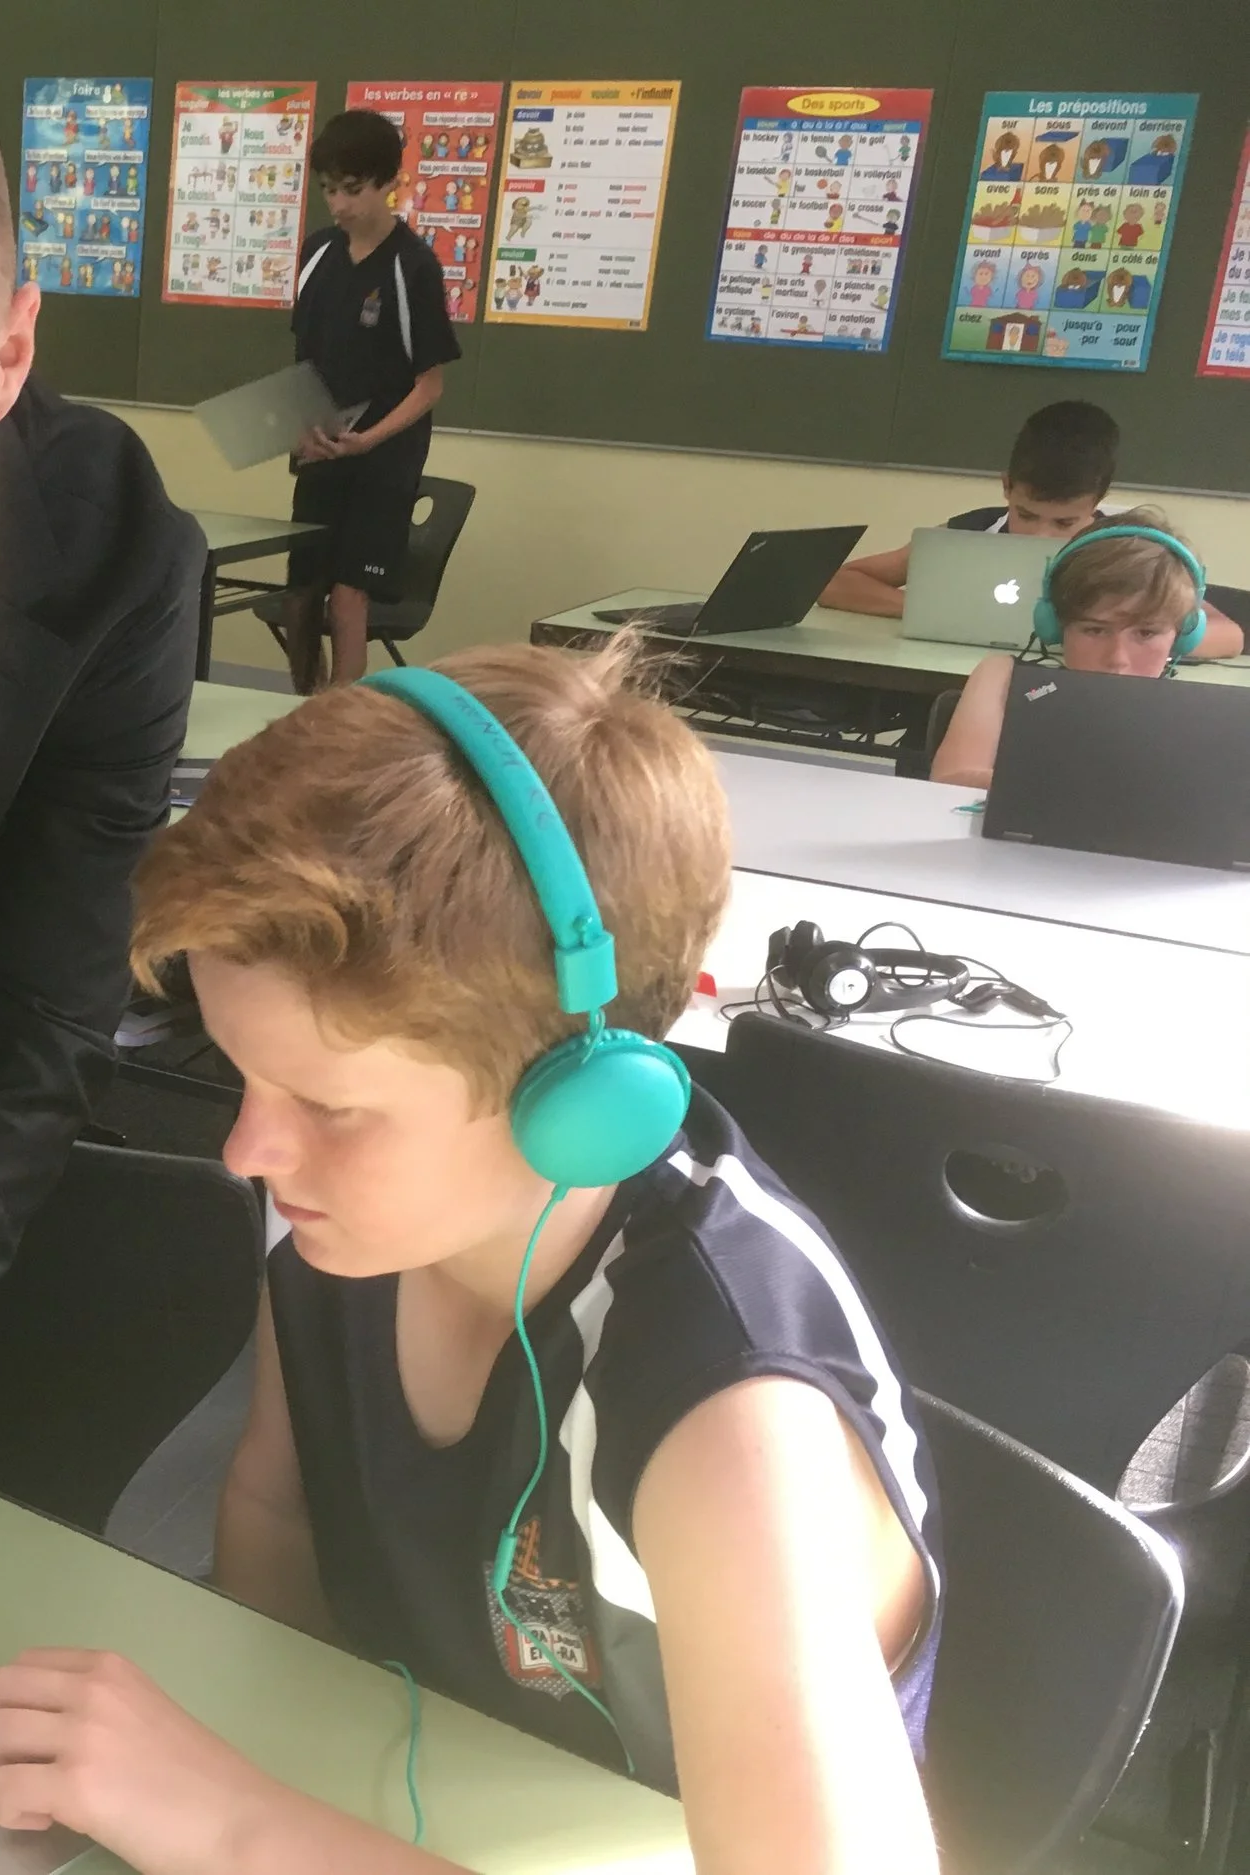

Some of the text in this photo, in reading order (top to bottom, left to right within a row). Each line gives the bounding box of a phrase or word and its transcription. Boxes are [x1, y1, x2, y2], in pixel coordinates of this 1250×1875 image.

[364, 87, 468, 101] les verbes en re
[802, 98, 866, 112] Des sports
[1029, 98, 1147, 117] Les prépositions
[1001, 120, 1019, 129] sur
[1046, 120, 1071, 130] sous
[1091, 120, 1128, 131] devant
[743, 133, 779, 143] le hockey
[801, 134, 835, 143] le tennis
[859, 135, 885, 146] le golf
[738, 166, 777, 175] le baseball
[795, 168, 845, 177] le basketball
[854, 170, 902, 180] le volleyball
[986, 185, 1010, 194] avec
[1035, 185, 1059, 195] sans
[1104, 186, 1117, 197] de
[1129, 187, 1167, 198] loin de
[733, 199, 766, 209] le soccer
[789, 201, 828, 210] le football
[857, 204, 884, 212] crosse
[725, 242, 745, 251] le ski
[782, 245, 836, 256] la gymnastique
[973, 249, 1001, 258] avant
[1021, 250, 1050, 261] après
[1072, 251, 1097, 262] dans
[1145, 253, 1158, 265] de
[1231, 247, 1245, 261] Je
[1229, 265, 1242, 279] du
[721, 274, 761, 285] le patinage
[776, 277, 805, 286] les arts
[719, 286, 752, 295] artistique
[834, 280, 875, 291] la planche
[775, 288, 808, 298] martiaux
[840, 292, 862, 302] neige
[1223, 289, 1236, 303] Je
[716, 306, 756, 318] le cyclisme
[771, 310, 799, 319] l'aviron
[1219, 308, 1241, 320] mes
[828, 313, 875, 324] la natation
[959, 313, 982, 323] chez
[1114, 322, 1141, 334] pour
[1113, 336, 1138, 347] sauf
[1215, 330, 1228, 343] Je
[1212, 348, 1221, 361] la
[364, 564, 385, 576] MGS
